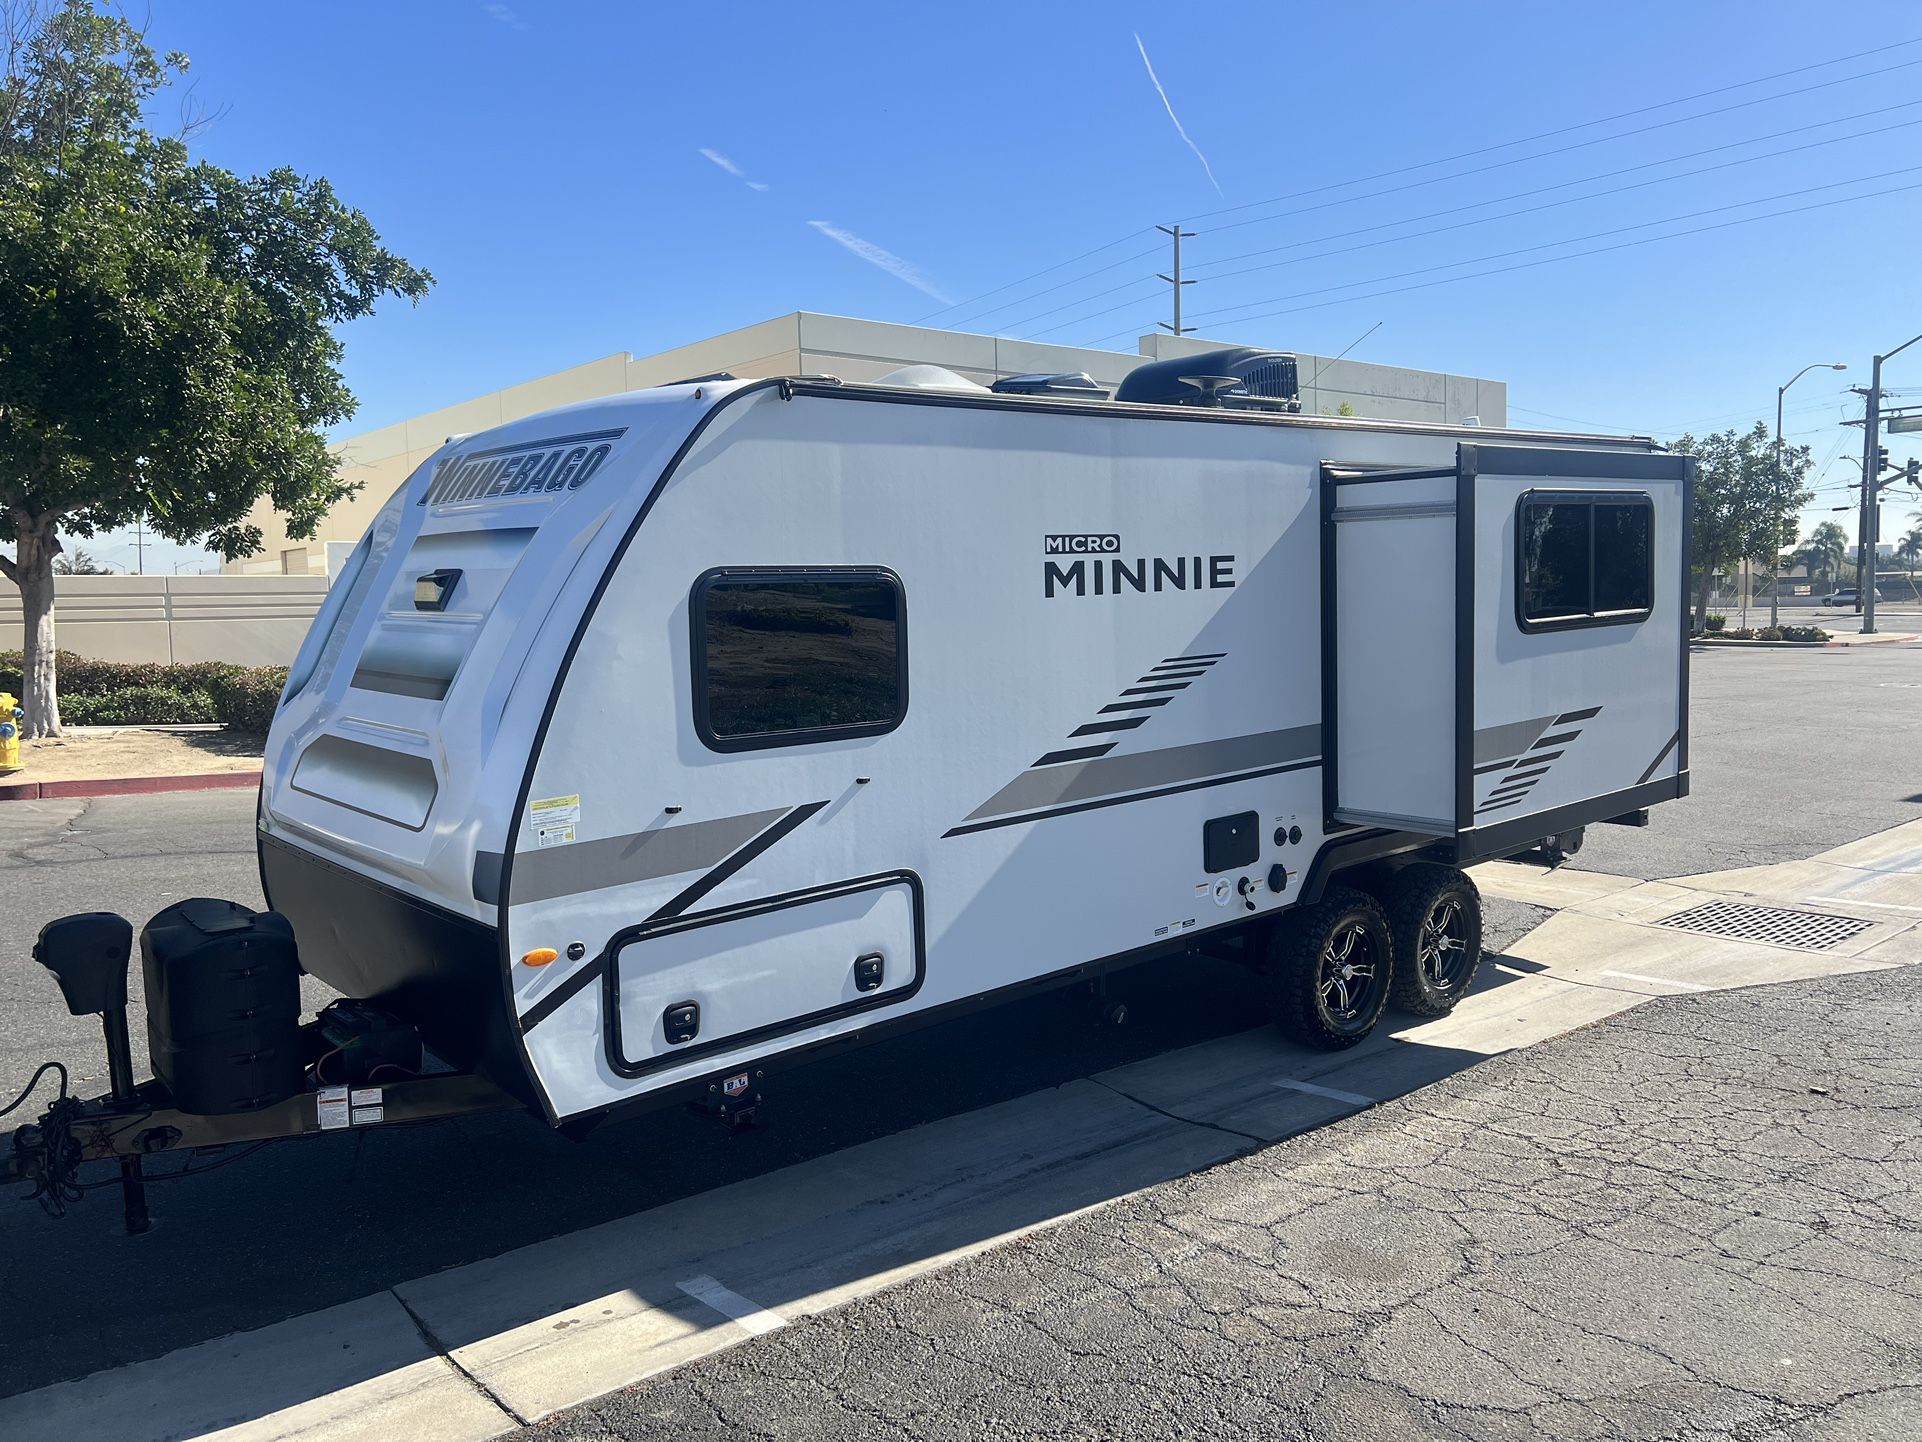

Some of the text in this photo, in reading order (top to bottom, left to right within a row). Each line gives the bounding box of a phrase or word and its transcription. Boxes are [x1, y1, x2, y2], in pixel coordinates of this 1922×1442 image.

[416, 443, 612, 507] WINNEBAGO
[1046, 536, 1119, 552] MICRO
[1044, 555, 1236, 598] MINNIE
[726, 1078, 746, 1091] BL
